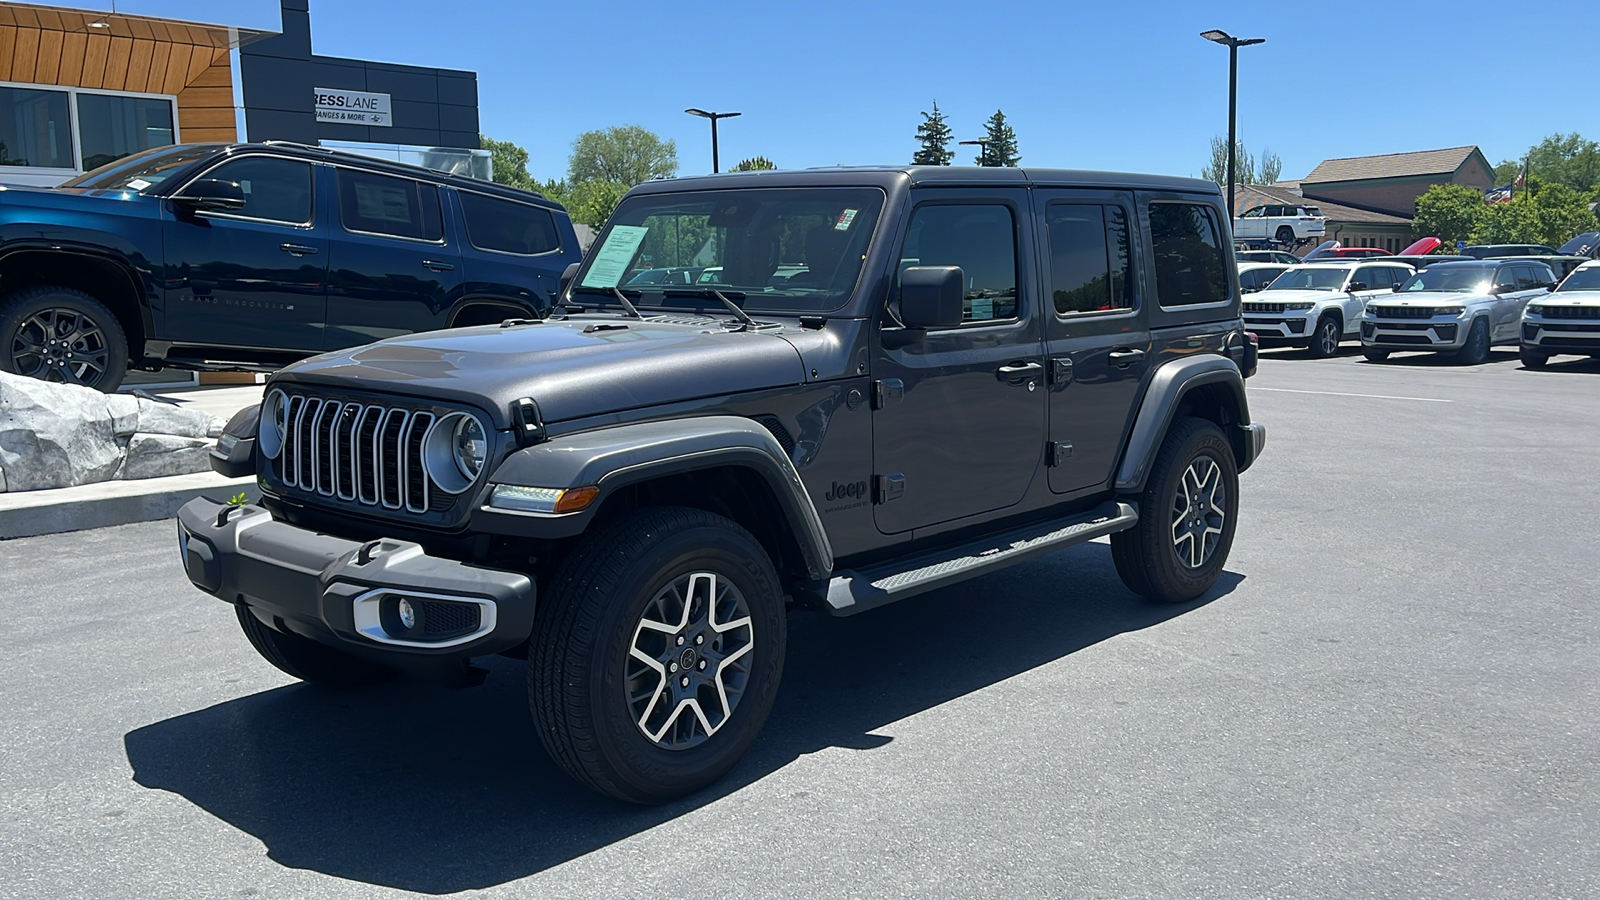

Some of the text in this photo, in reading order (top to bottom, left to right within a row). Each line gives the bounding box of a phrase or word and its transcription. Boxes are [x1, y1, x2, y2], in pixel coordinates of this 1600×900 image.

[347, 113, 365, 121] MORE
[180, 295, 284, 310] GRAND WAGONEER
[825, 481, 867, 502] Jeep
